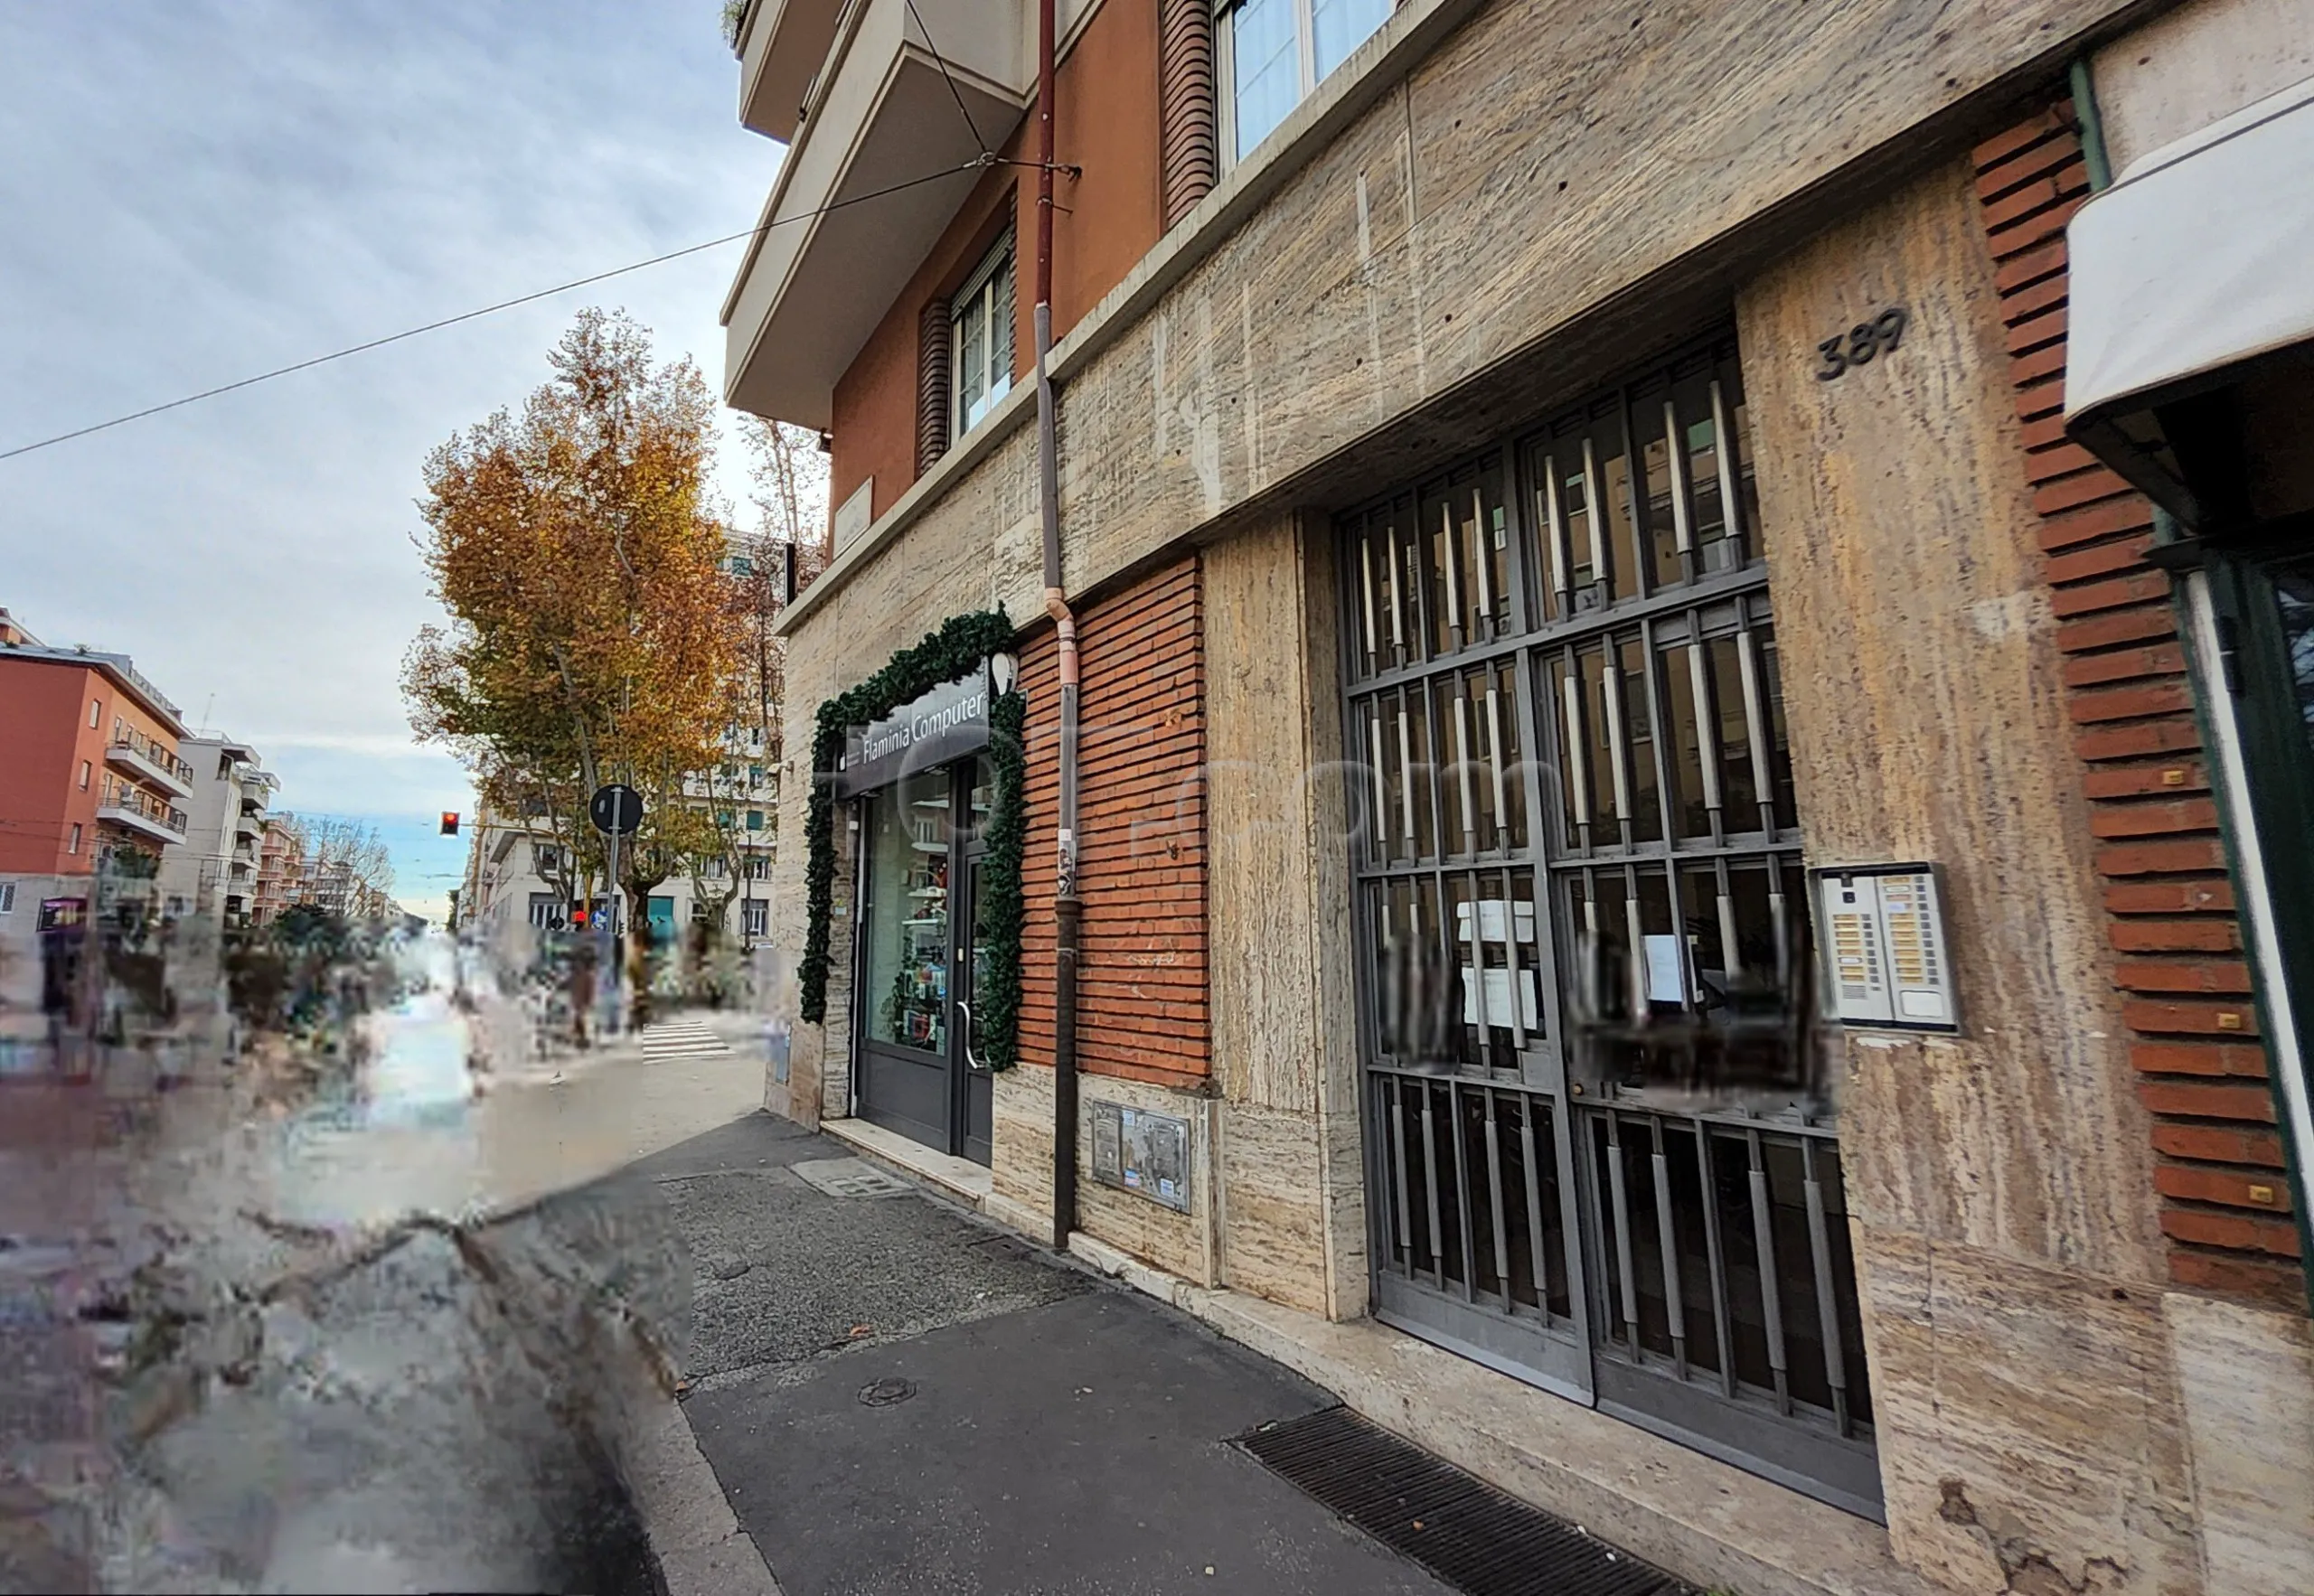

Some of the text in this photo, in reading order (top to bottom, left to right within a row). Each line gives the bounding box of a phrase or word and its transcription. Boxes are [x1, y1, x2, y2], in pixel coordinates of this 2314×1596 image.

[1816, 308, 1910, 381] 389
[863, 691, 985, 764] Flaminia Computer
